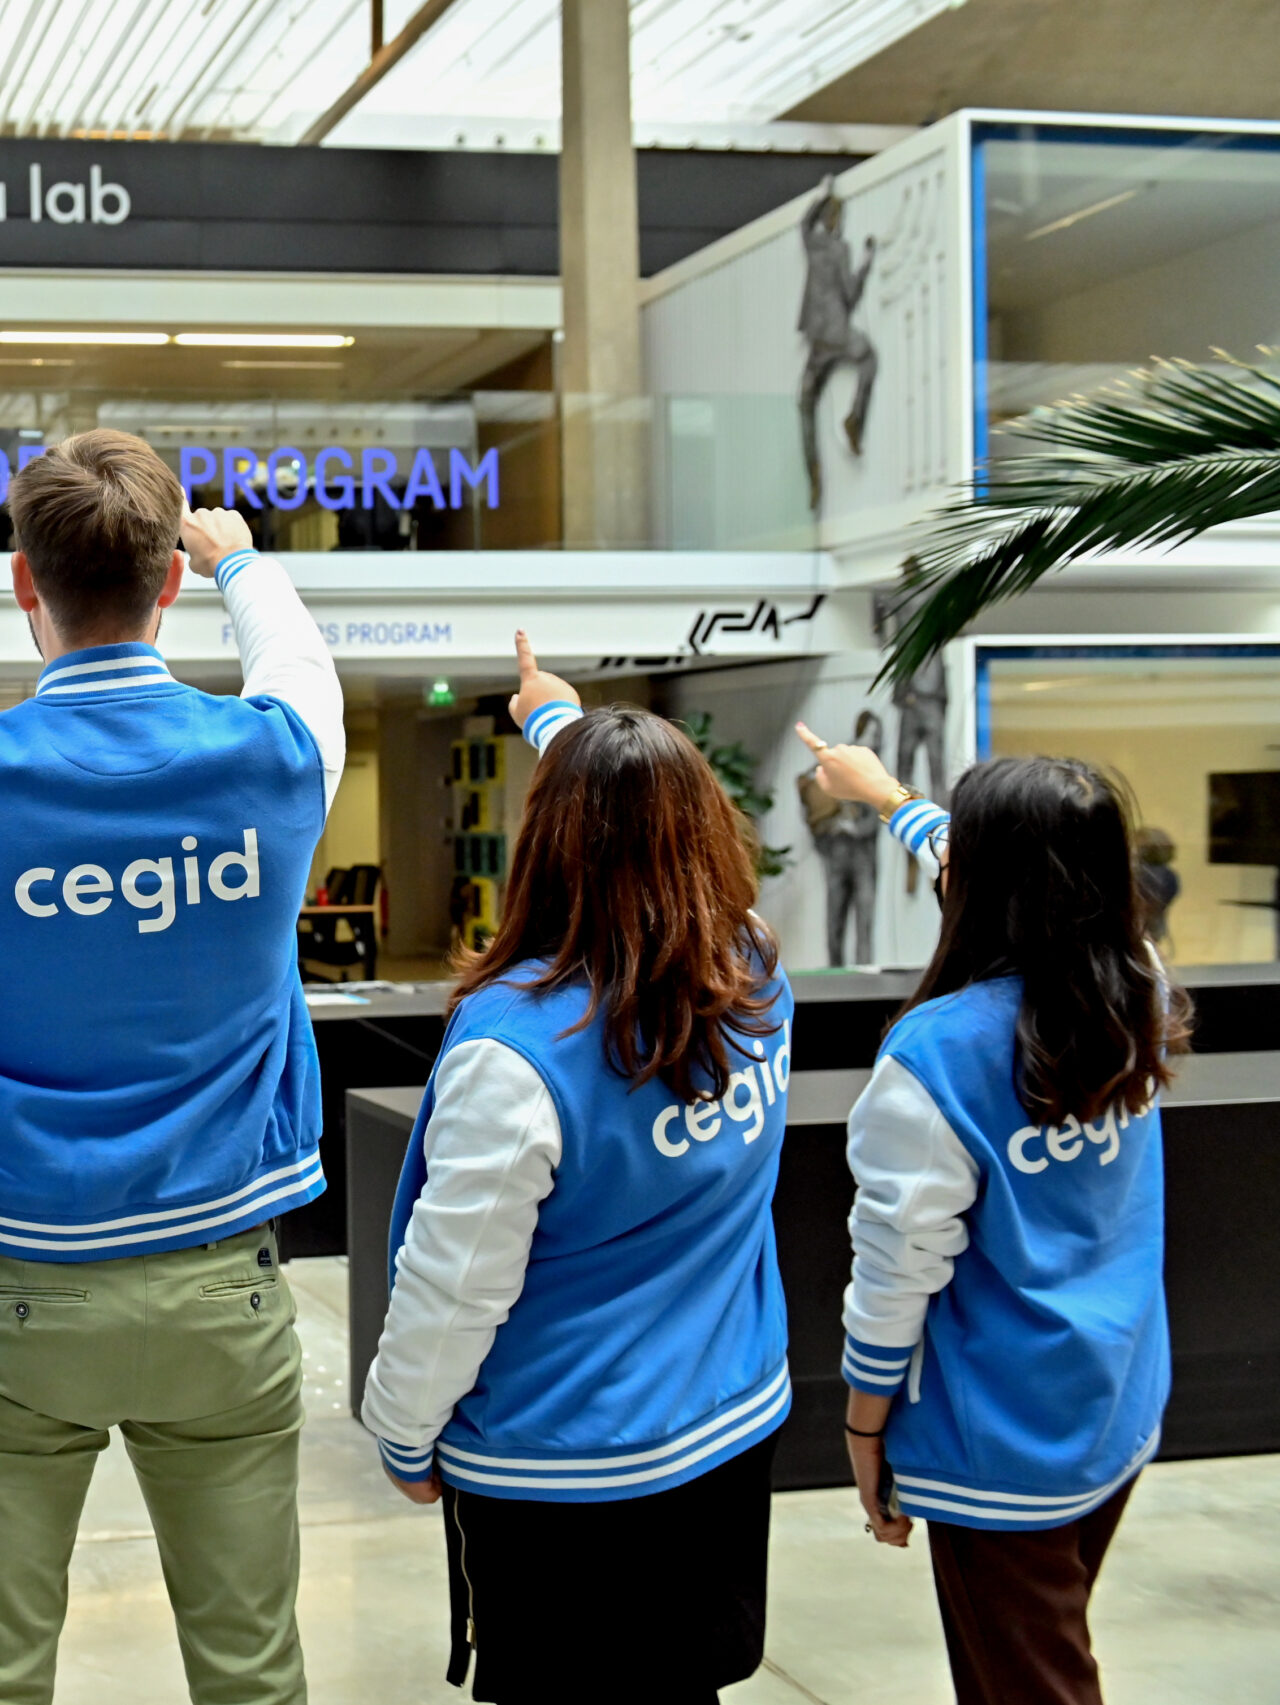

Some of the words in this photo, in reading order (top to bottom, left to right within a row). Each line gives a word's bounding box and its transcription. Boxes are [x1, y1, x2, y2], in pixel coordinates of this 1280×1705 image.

[29, 163, 131, 224] lab
[180, 446, 499, 510] PROGRAM
[346, 622, 452, 646] PROGRAM
[14, 828, 260, 934] cegid
[652, 1018, 792, 1158] cegid
[1007, 1074, 1155, 1175] ceg
